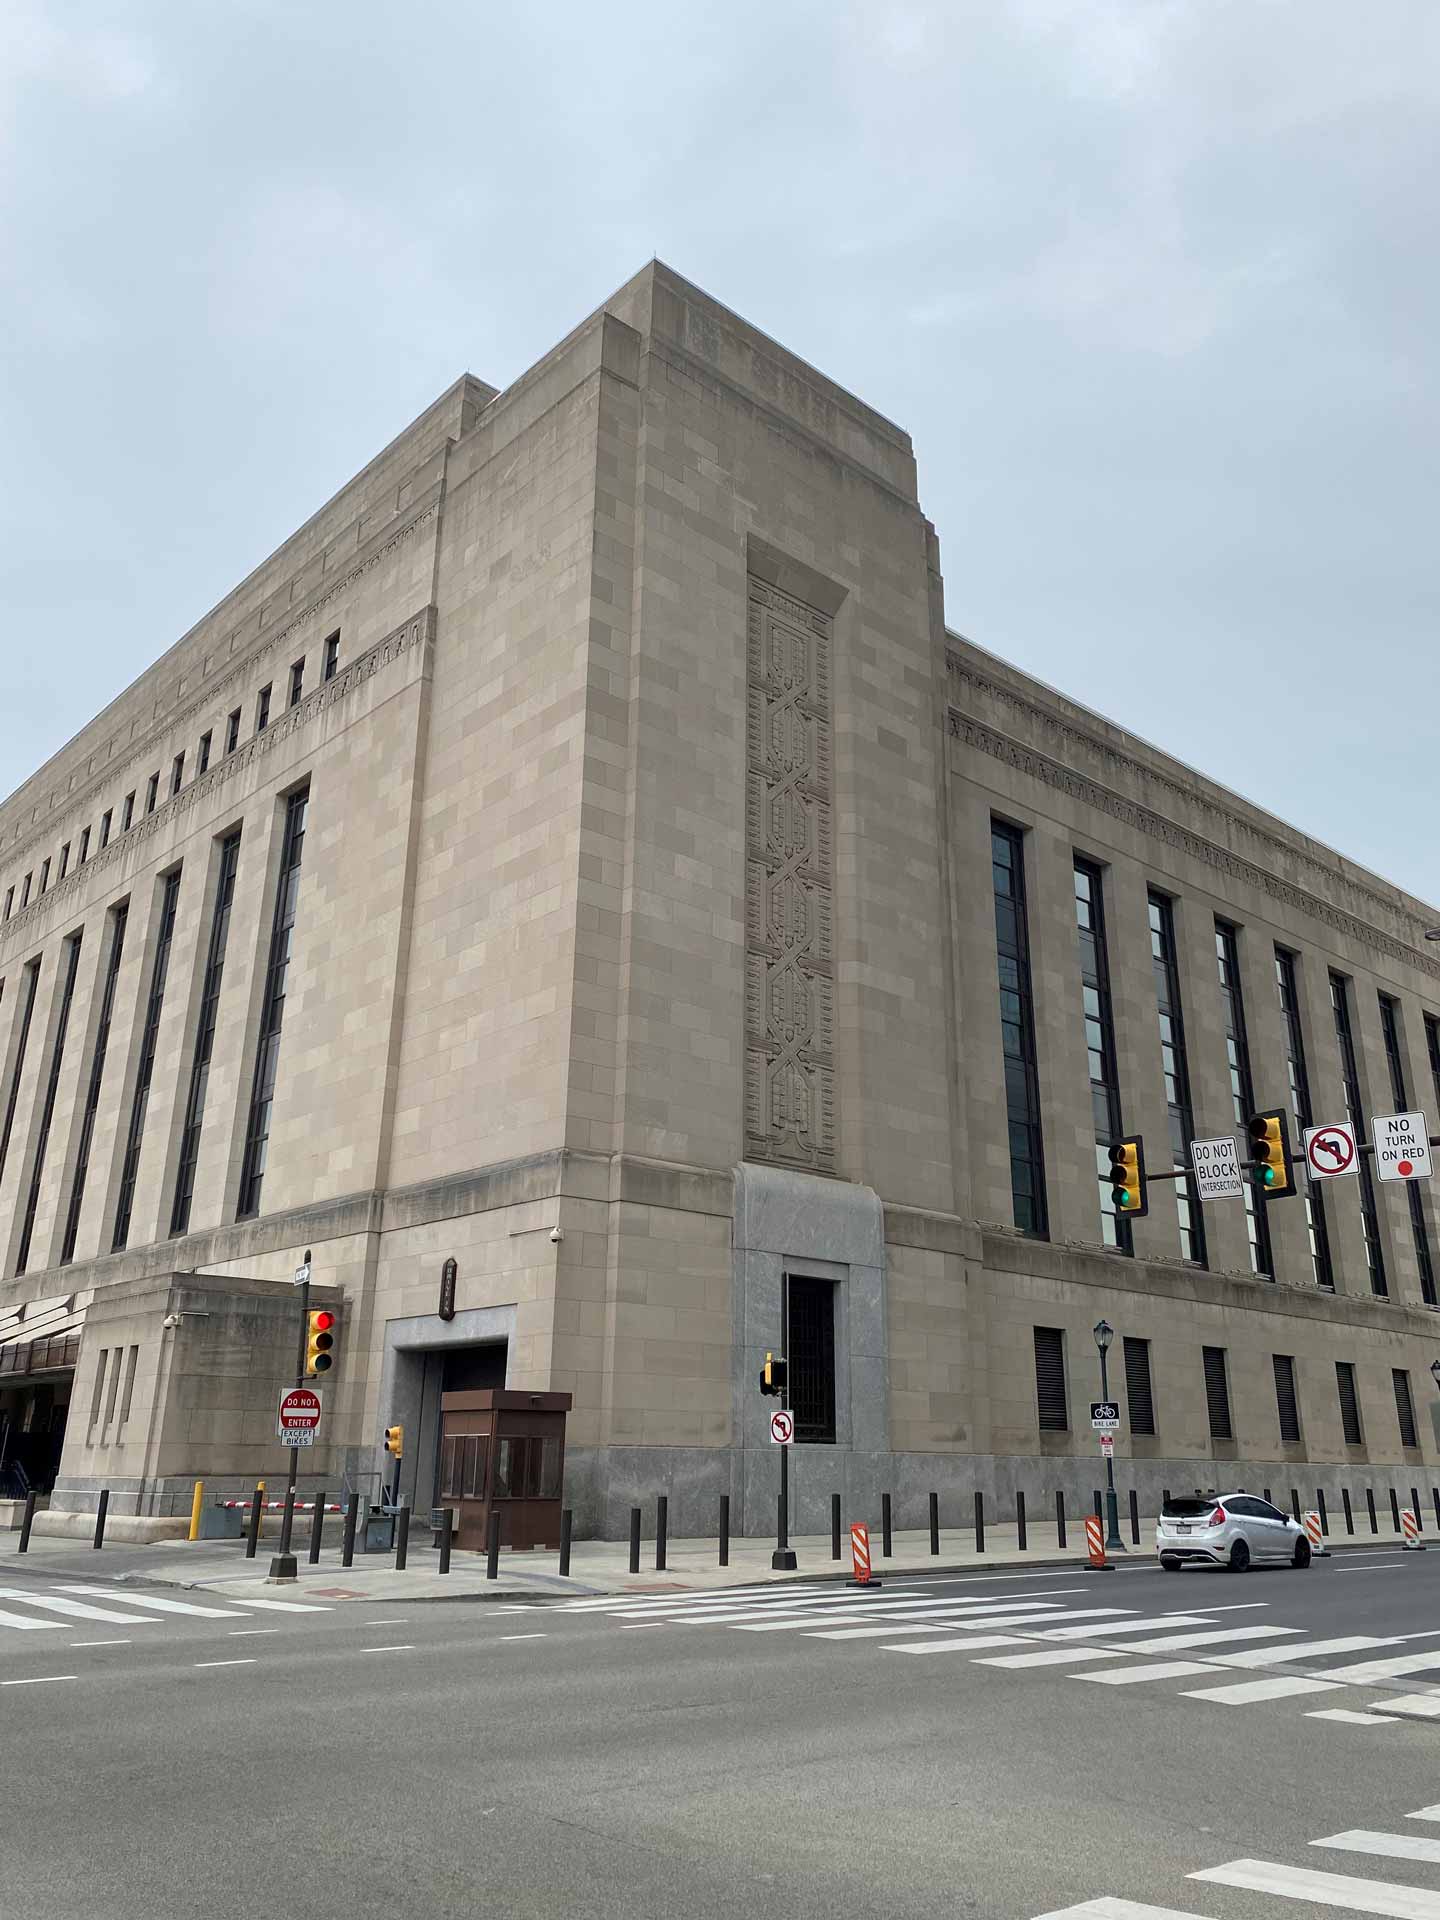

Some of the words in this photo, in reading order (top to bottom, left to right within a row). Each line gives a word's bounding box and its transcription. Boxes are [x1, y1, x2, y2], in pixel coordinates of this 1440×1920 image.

[1388, 1119, 1410, 1133] NO
[1385, 1134, 1415, 1147] TURN
[1195, 1146, 1210, 1160] DO
[1213, 1143, 1233, 1158] NOT
[1382, 1150, 1397, 1161] ON
[1402, 1147, 1425, 1159] RED
[1198, 1162, 1237, 1179] BLOCK
[1201, 1180, 1241, 1192] INTERSECTION
[287, 1398, 298, 1406] DO
[301, 1398, 317, 1406] NOT
[288, 1418, 312, 1427] ENTER
[287, 1437, 308, 1445] BIKES
